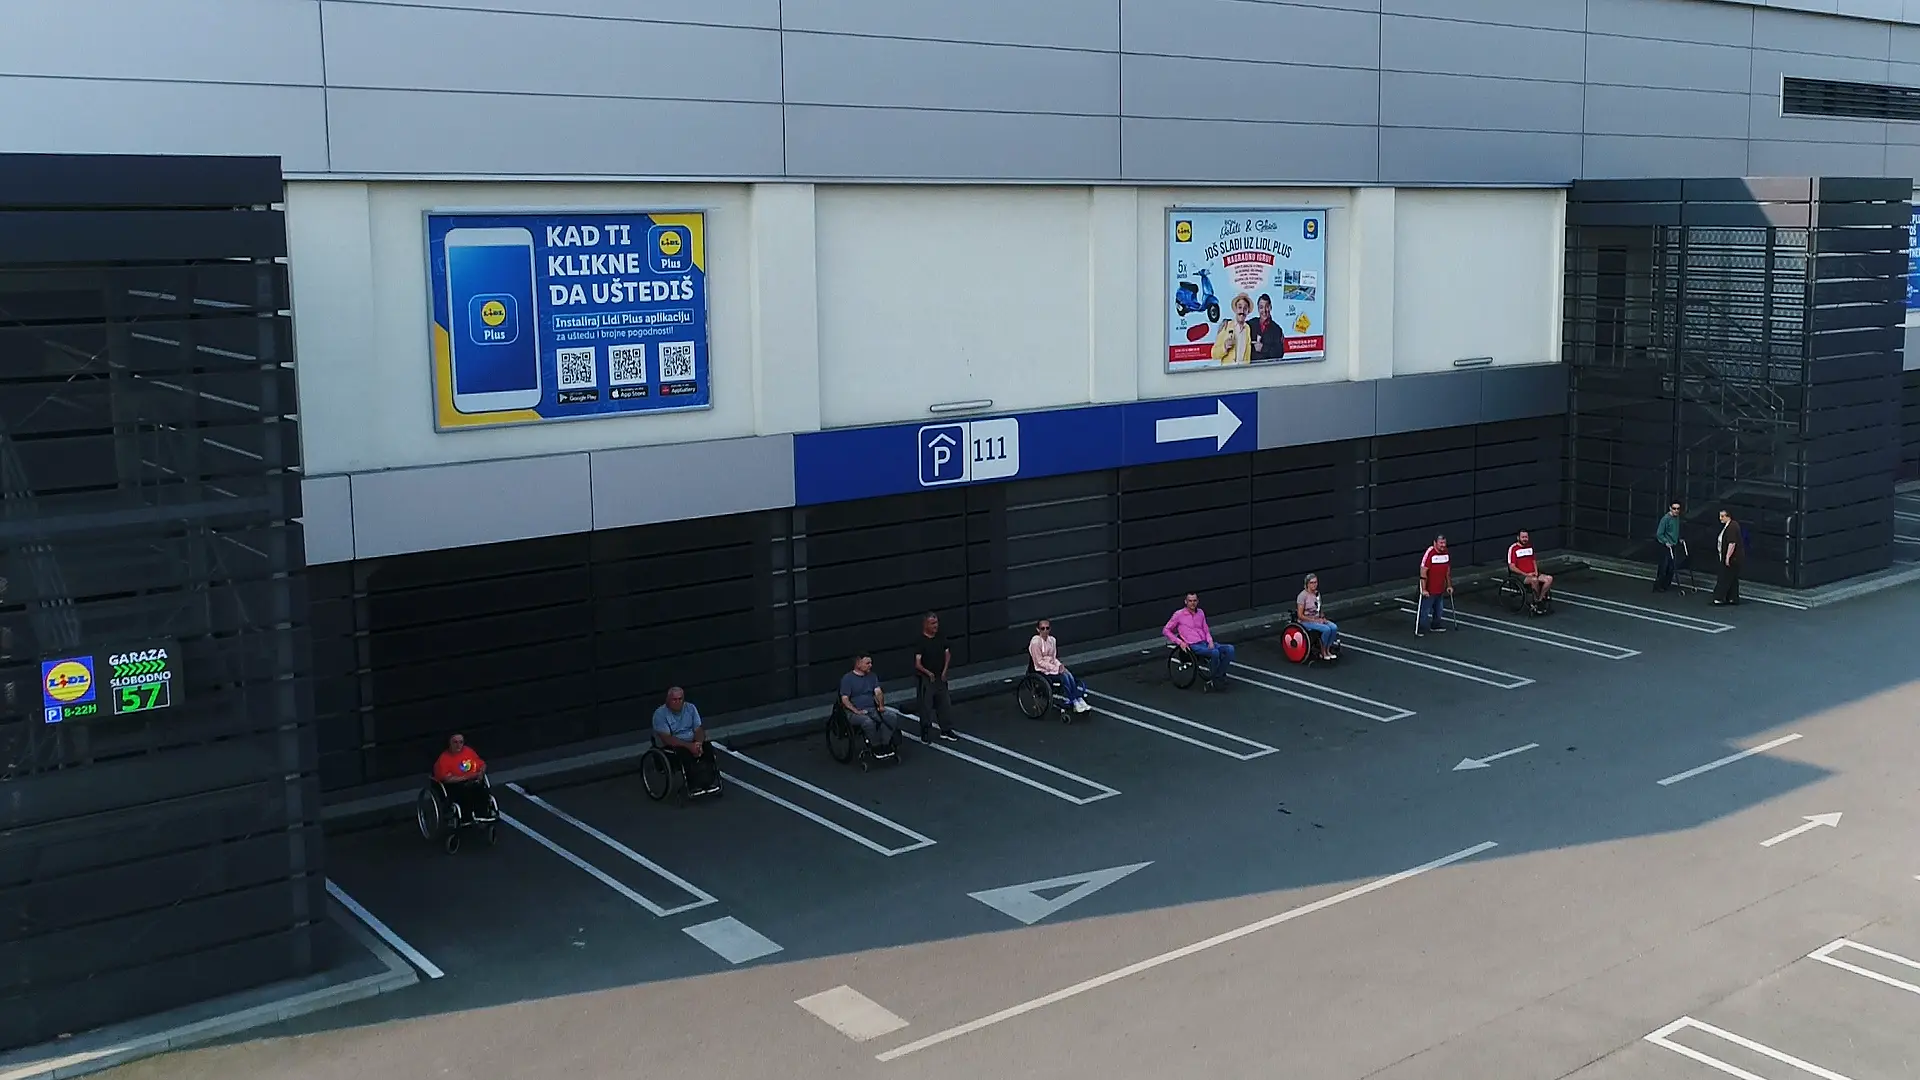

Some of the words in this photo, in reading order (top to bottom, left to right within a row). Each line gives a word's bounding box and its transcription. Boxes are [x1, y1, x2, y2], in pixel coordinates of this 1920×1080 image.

[546, 225, 600, 247] KAD
[605, 224, 631, 246] TI
[1204, 242, 1219, 261] JOŠ
[1244, 237, 1254, 250] UZ
[1256, 237, 1271, 252] LIDL
[1273, 240, 1293, 258] PLUS
[548, 253, 640, 277] KLIKNE
[661, 258, 681, 269] Plus
[549, 284, 587, 306] DA
[592, 275, 694, 304] UŠTEDIŠ
[555, 313, 600, 328] Instaliraj
[622, 312, 643, 325] Plus
[645, 310, 691, 326] aplikaciju
[484, 329, 506, 341] Plus
[556, 333, 566, 341] za
[567, 330, 595, 341] uštedu
[601, 329, 626, 340] brojne
[628, 326, 674, 339] pogodnosti!
[934, 446, 951, 477] P
[973, 436, 1007, 462] 111
[109, 648, 168, 666] GARAZA
[110, 671, 172, 687] SLOBODNO
[122, 683, 161, 712] 57
[48, 710, 57, 720] P
[64, 704, 97, 717] 8-22H
